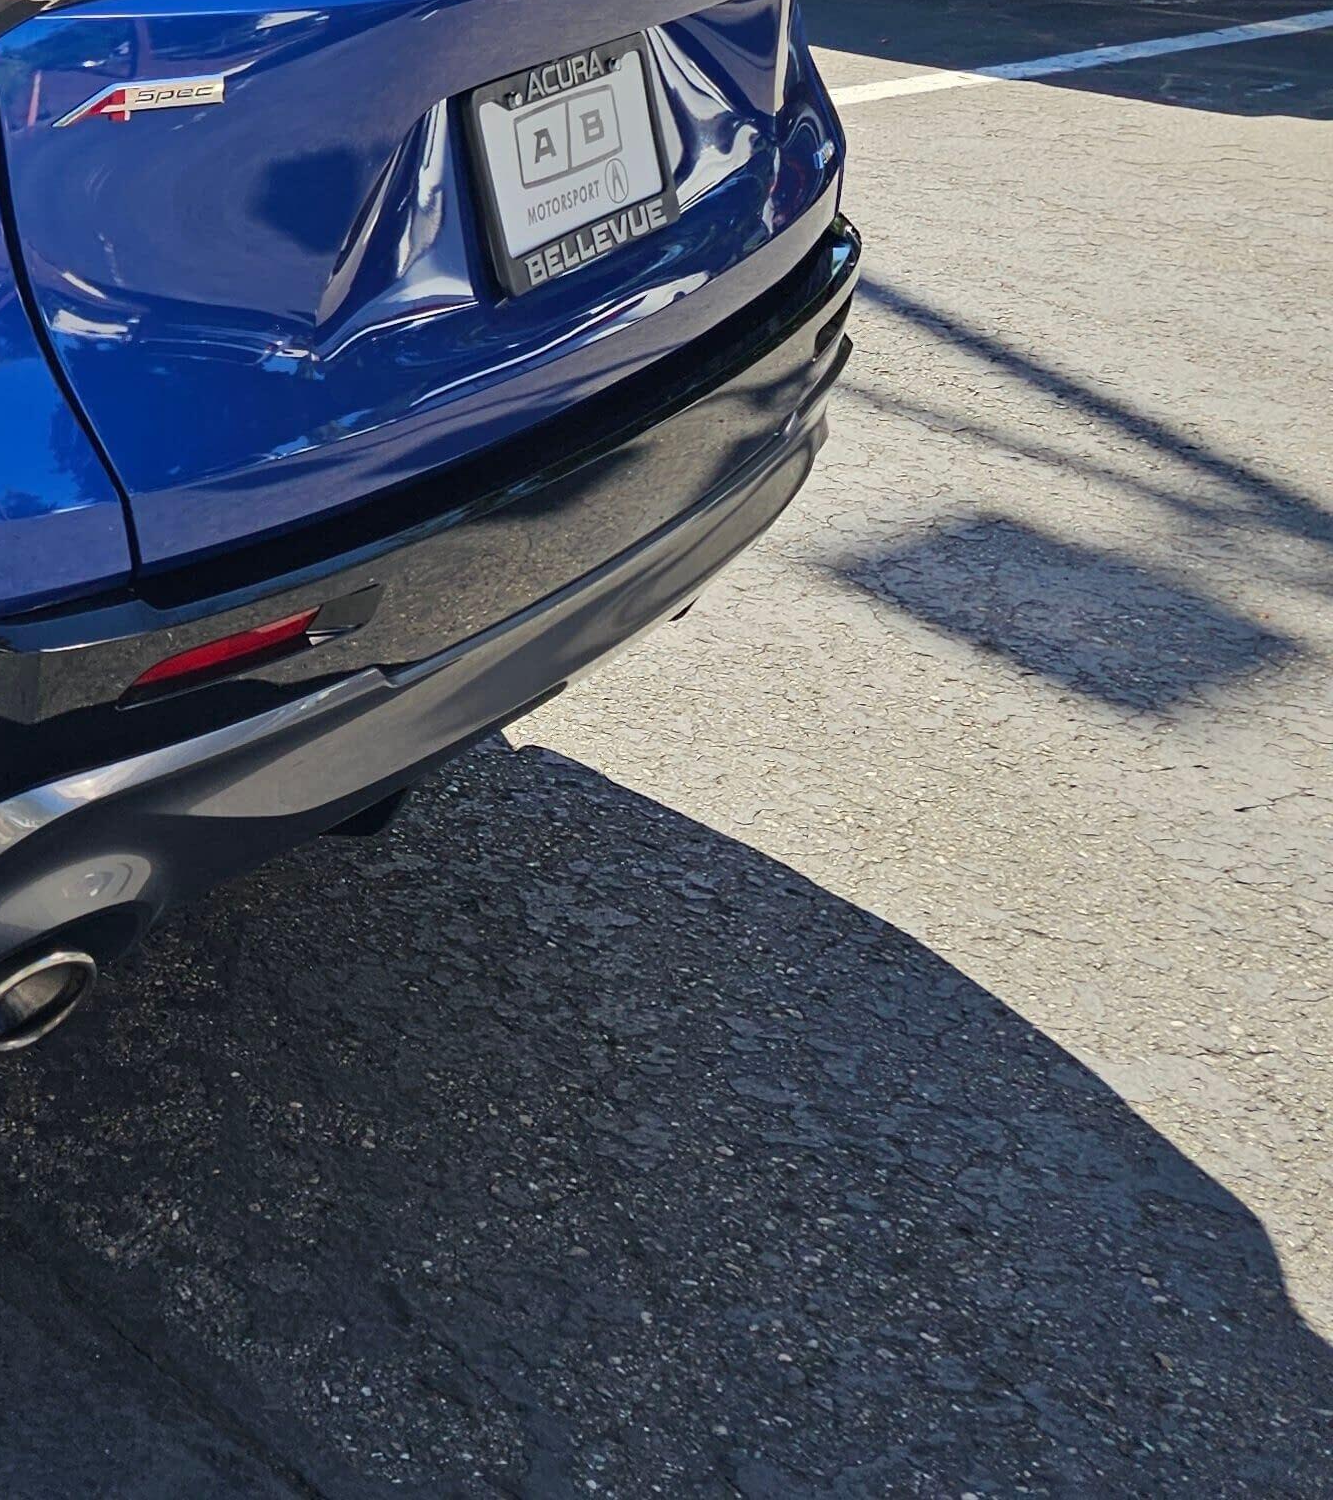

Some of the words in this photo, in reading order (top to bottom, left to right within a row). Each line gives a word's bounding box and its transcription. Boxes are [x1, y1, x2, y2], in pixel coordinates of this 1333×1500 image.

[527, 50, 605, 102] ACURA
[533, 127, 557, 164] A
[578, 108, 605, 145] B
[527, 179, 600, 227] MOTORSPORT
[524, 198, 668, 287] BELLEVUE
